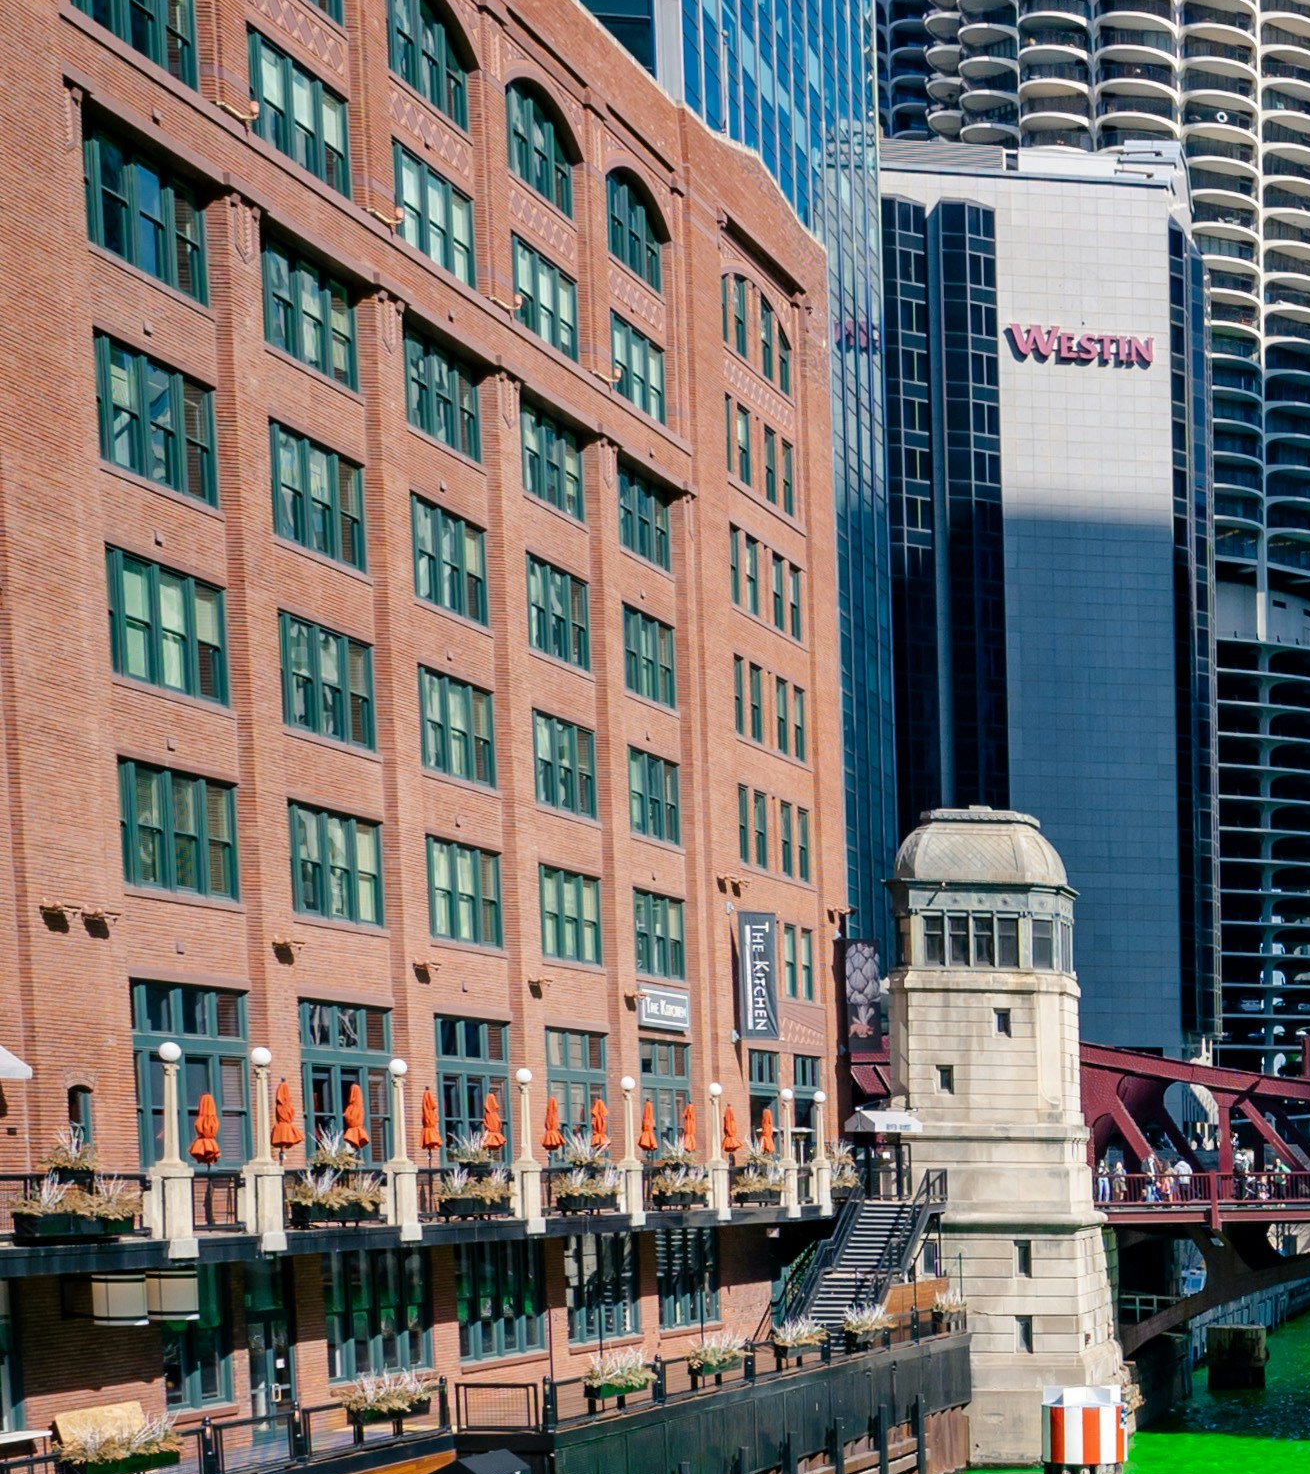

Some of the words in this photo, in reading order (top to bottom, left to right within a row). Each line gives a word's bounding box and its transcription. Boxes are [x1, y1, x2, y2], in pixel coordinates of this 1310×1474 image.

[1009, 323, 1154, 363] WESTIN
[752, 921, 769, 952] THE
[753, 961, 770, 1031] KITCHEN
